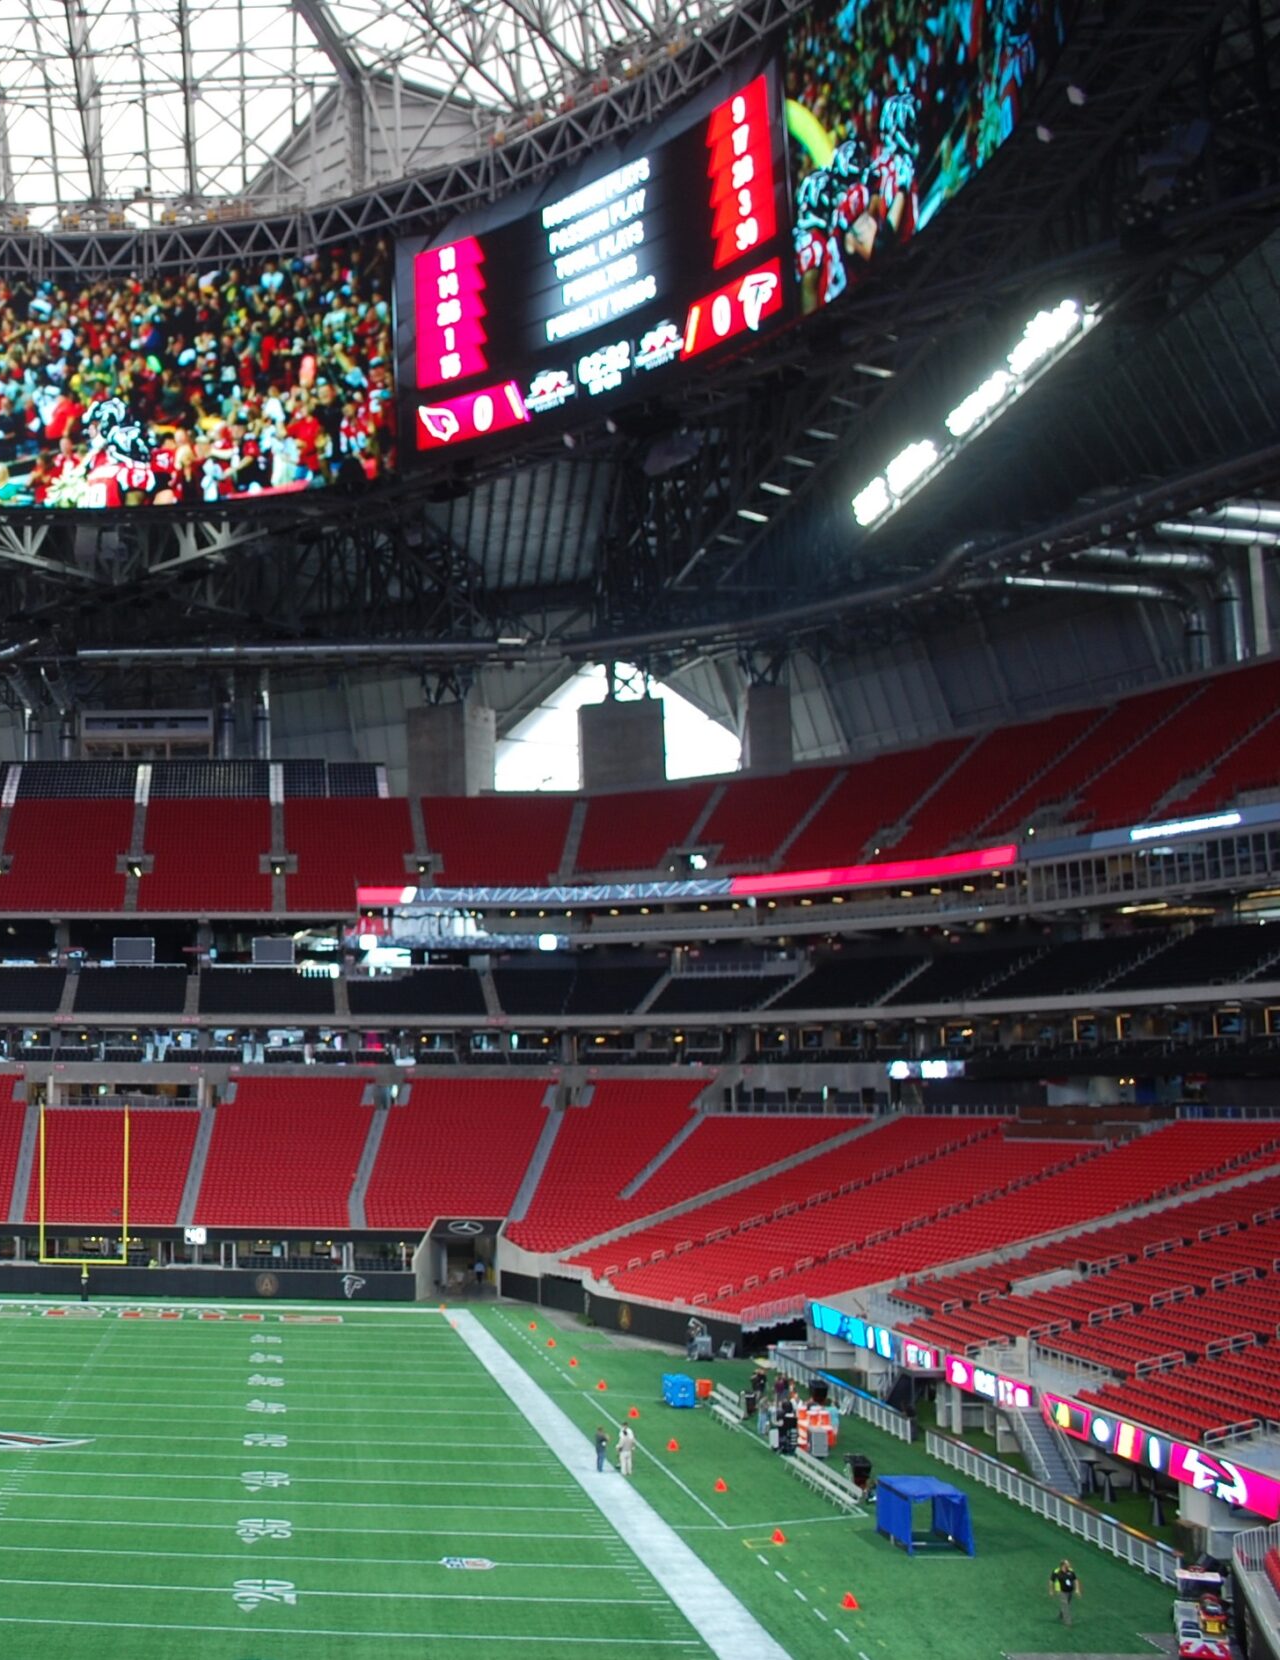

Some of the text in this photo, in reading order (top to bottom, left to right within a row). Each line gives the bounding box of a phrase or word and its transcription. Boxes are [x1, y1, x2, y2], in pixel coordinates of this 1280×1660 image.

[712, 295, 732, 336] 0
[473, 395, 494, 431] 0
[186, 1229, 206, 1243] 40
[232, 1579, 296, 1605] 20
